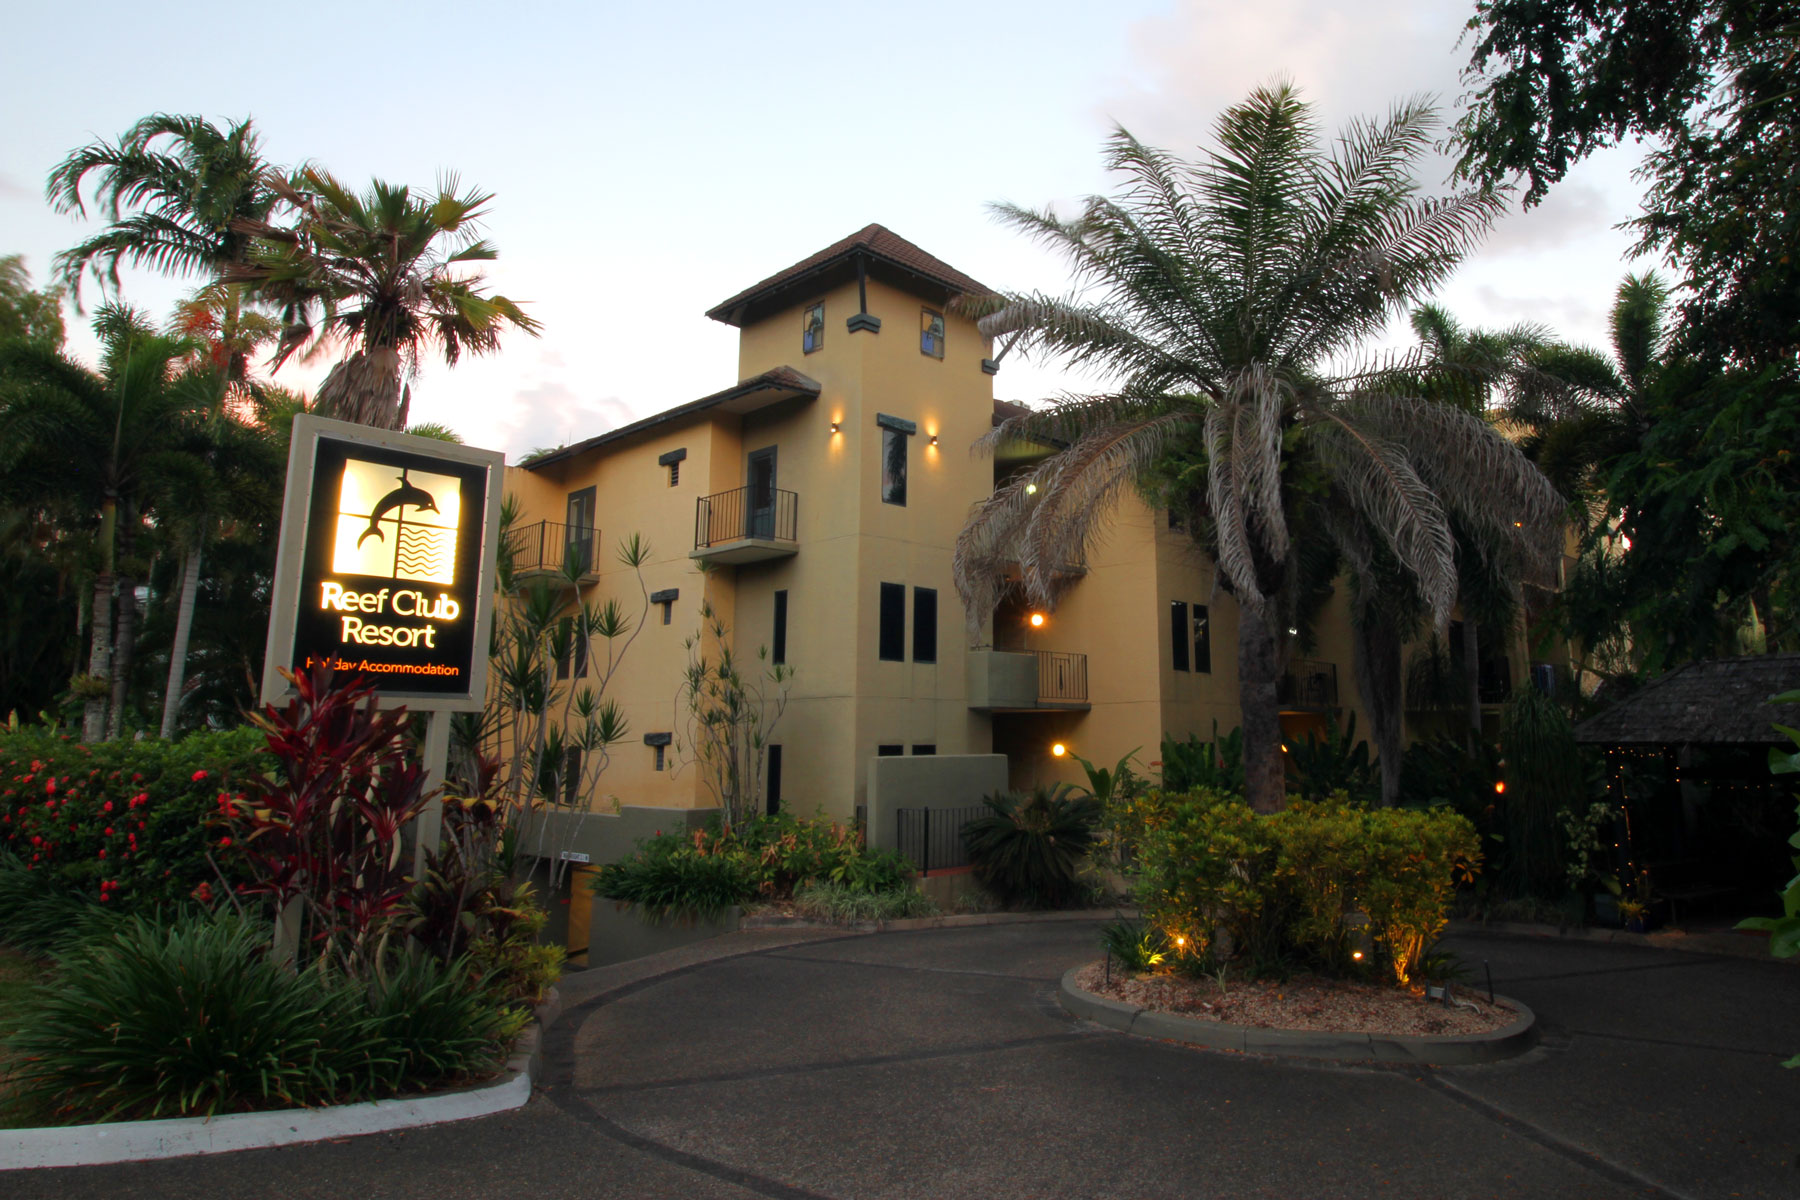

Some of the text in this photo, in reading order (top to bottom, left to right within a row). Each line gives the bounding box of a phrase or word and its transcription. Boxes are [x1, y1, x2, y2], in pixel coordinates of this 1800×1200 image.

[321, 582, 459, 620] Reef Club
[341, 616, 435, 648] Resort
[306, 656, 459, 676] Hday Accommodation
